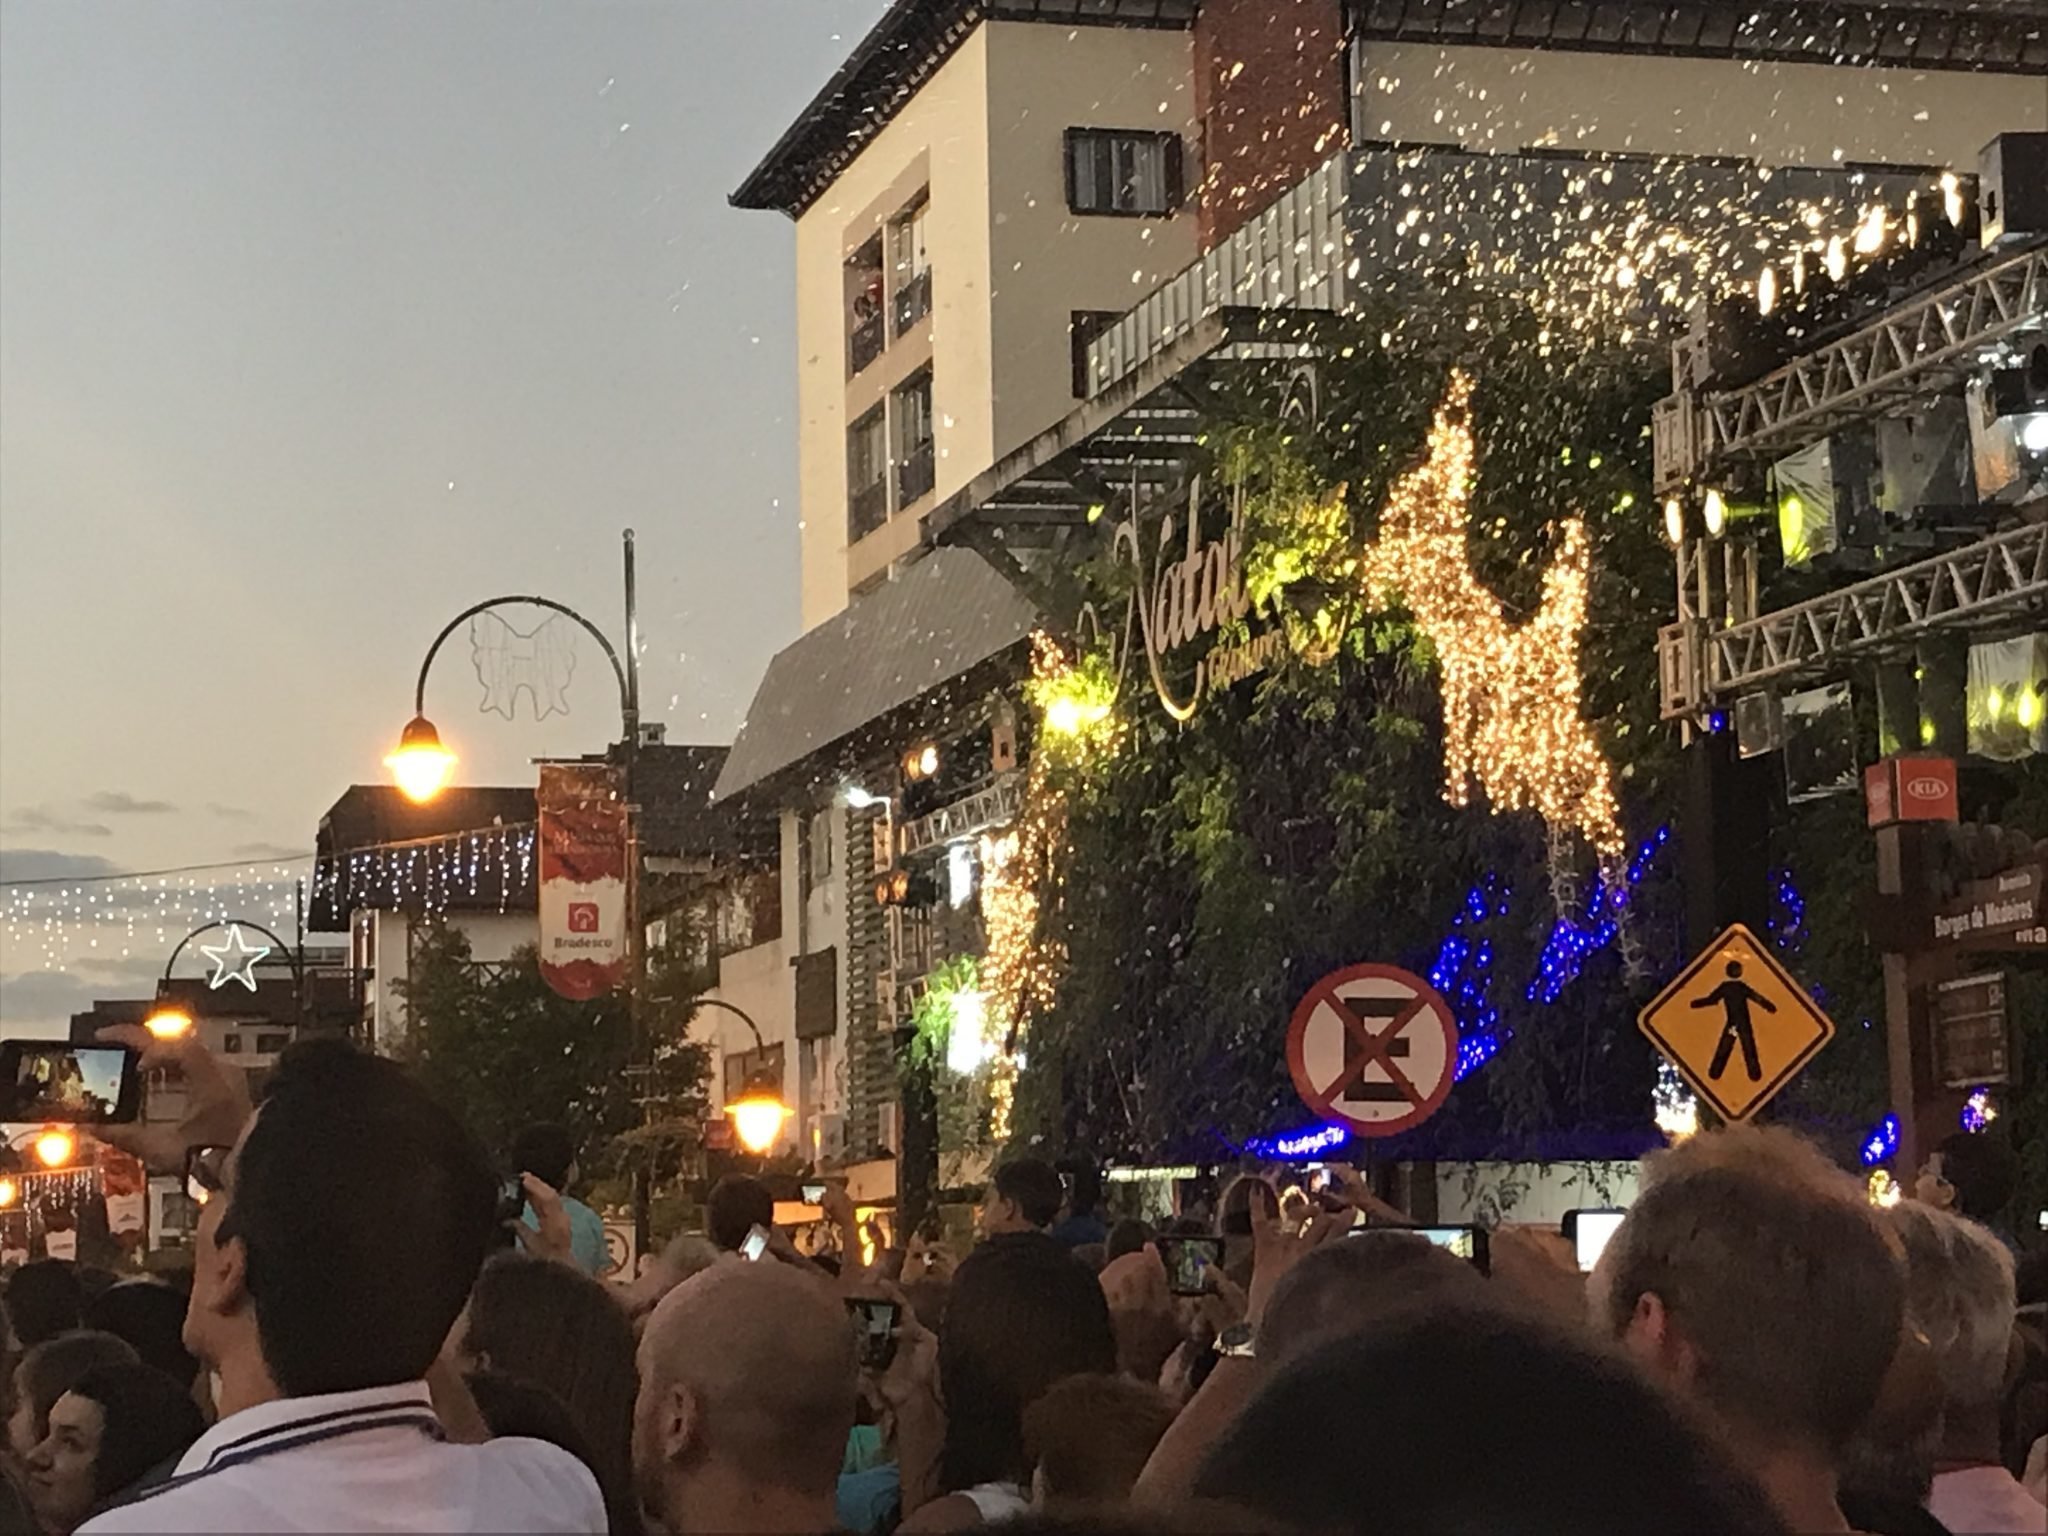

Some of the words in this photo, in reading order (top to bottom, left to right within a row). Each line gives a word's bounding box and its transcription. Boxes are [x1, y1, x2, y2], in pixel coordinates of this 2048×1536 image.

[1912, 780, 1943, 796] KIA
[1934, 914, 1970, 939] Borges
[1971, 905, 1984, 928] de
[1985, 897, 2033, 926] Medeiros
[554, 936, 613, 949] Bradesco
